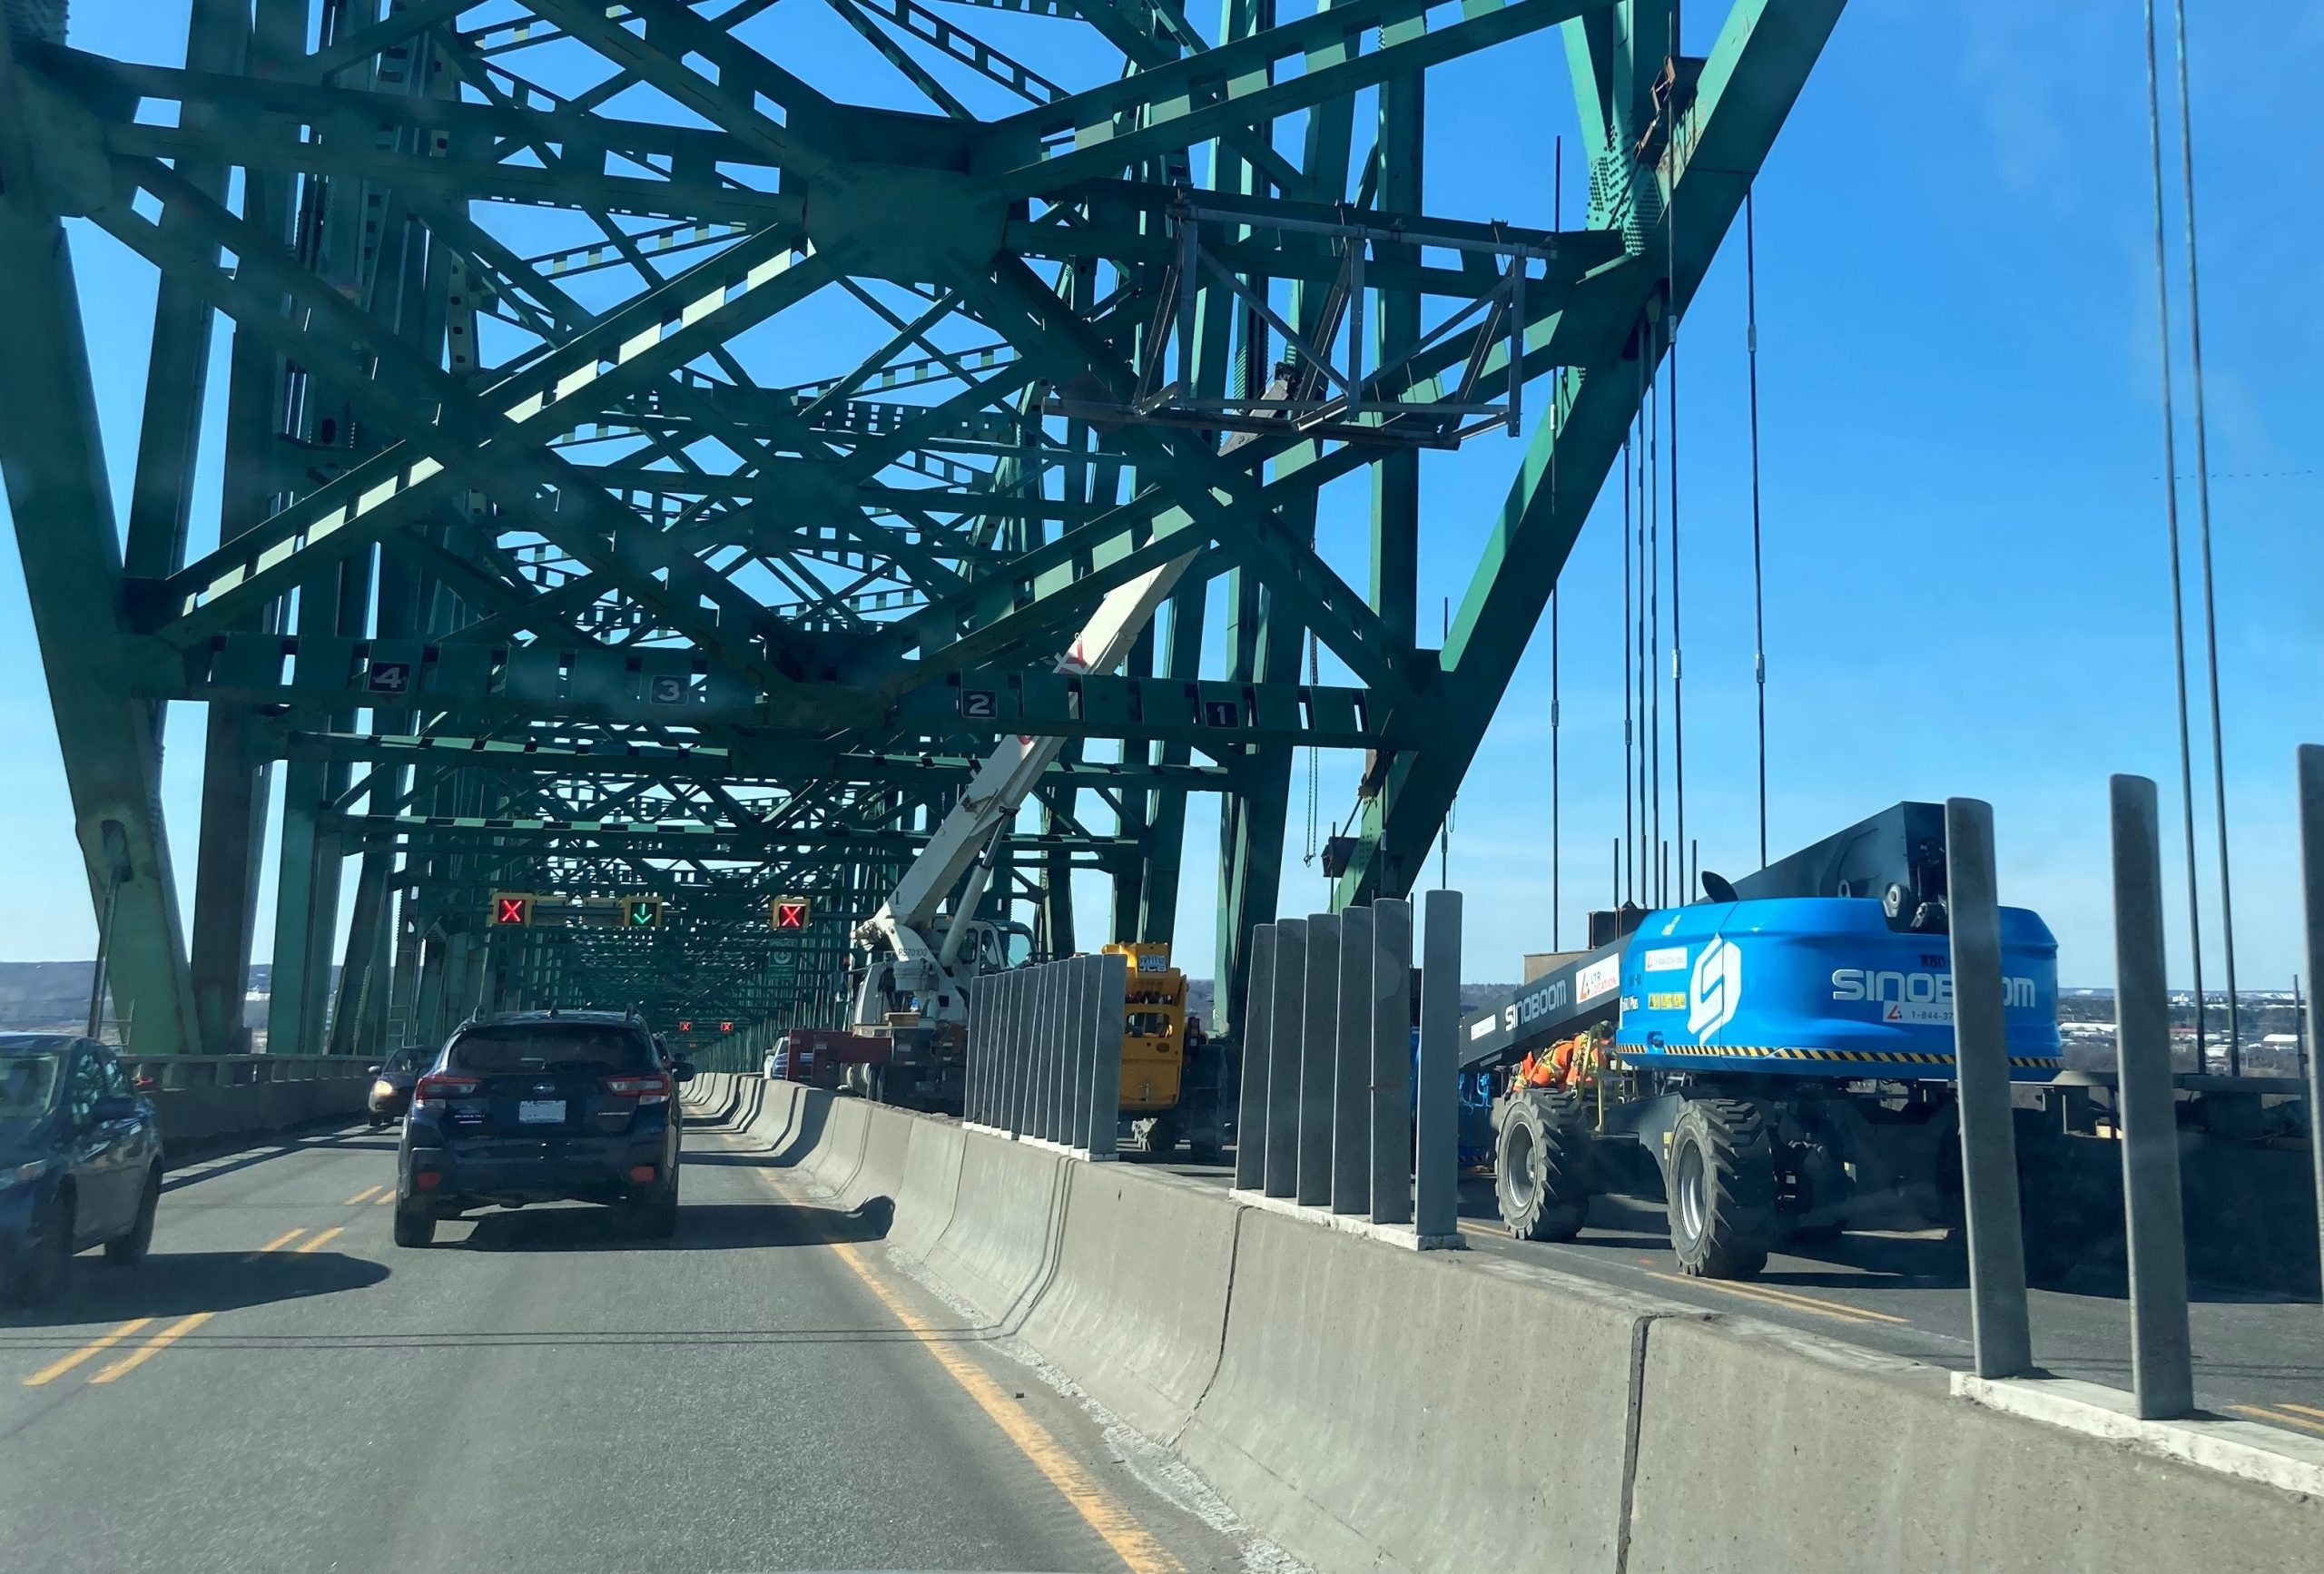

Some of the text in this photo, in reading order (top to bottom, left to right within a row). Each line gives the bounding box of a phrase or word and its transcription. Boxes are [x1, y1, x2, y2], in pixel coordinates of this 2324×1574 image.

[374, 667, 401, 688] 4
[658, 680, 679, 701] 3
[970, 694, 990, 714] 2
[1217, 705, 1226, 724] 1
[1832, 969, 2035, 1008] SINOBM
[1504, 979, 1567, 1032] SINOBOOM
